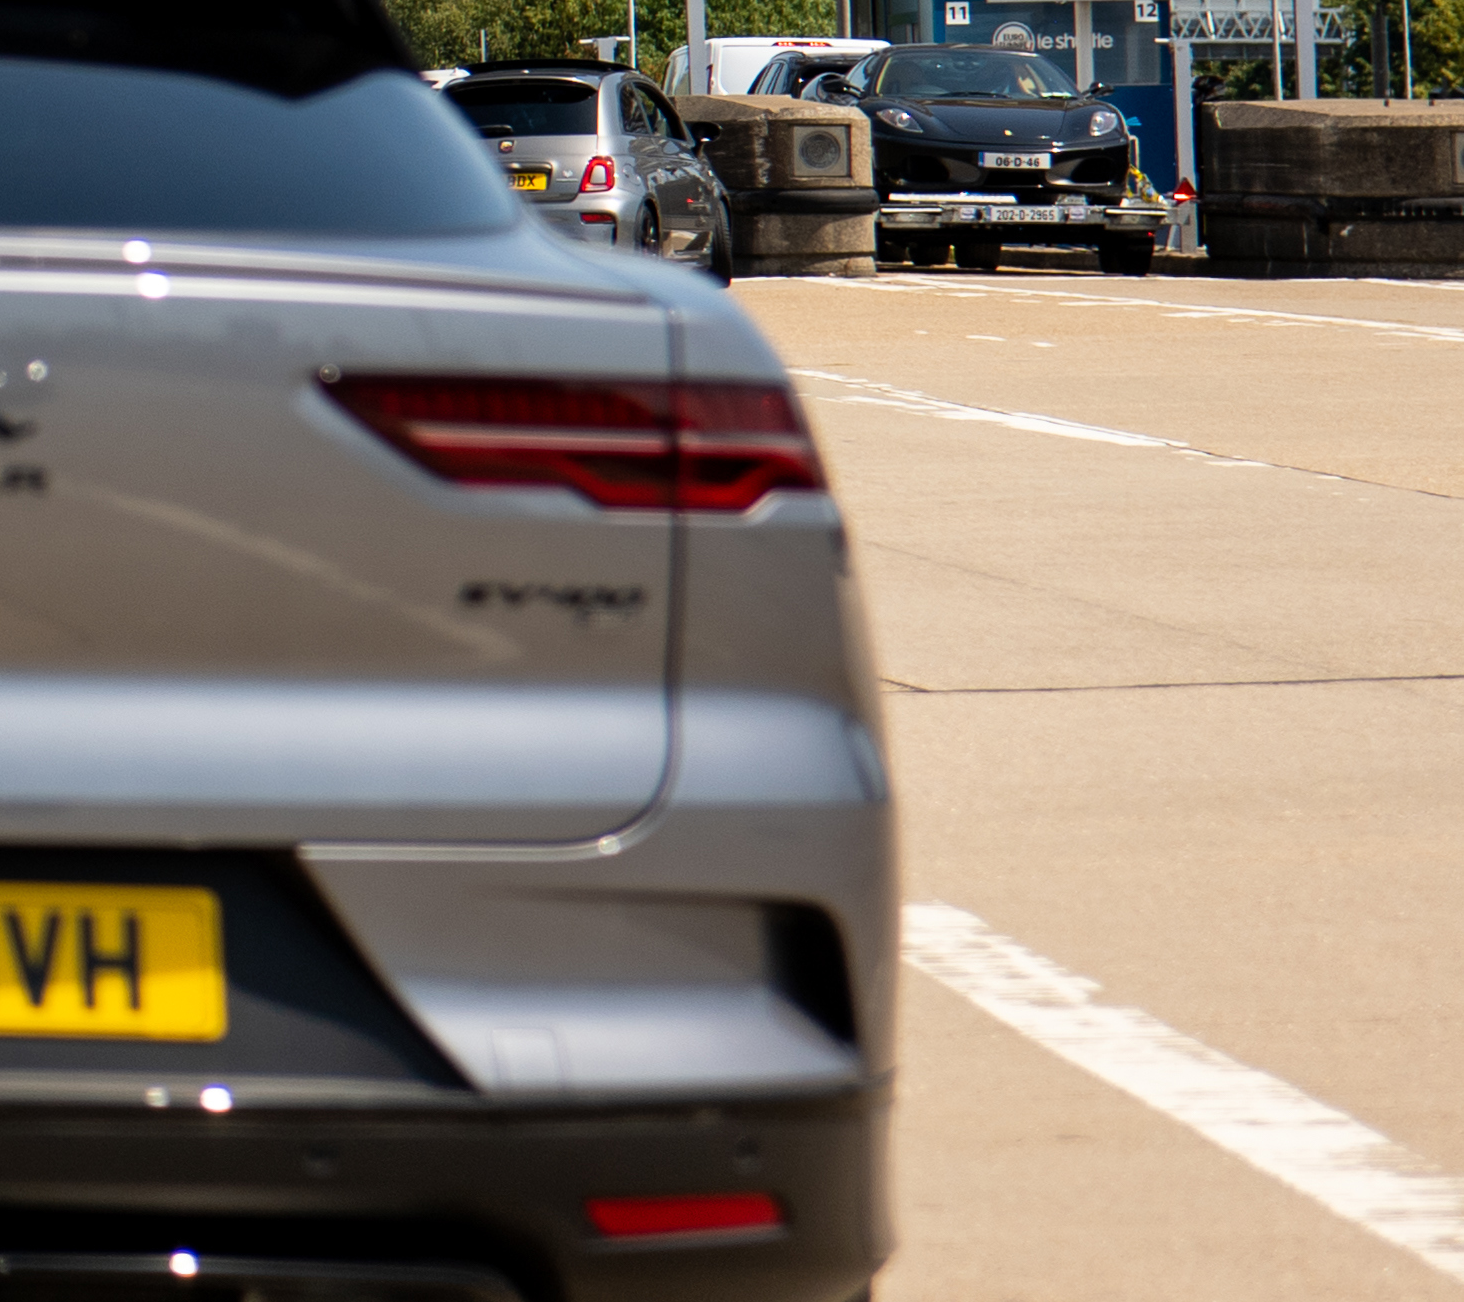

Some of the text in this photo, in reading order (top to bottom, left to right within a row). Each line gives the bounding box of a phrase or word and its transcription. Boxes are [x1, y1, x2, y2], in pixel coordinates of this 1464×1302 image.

[948, 5, 968, 20] 11
[1137, 3, 1159, 18] 12
[1036, 32, 1054, 50] le
[995, 156, 1040, 167] 06-D-46
